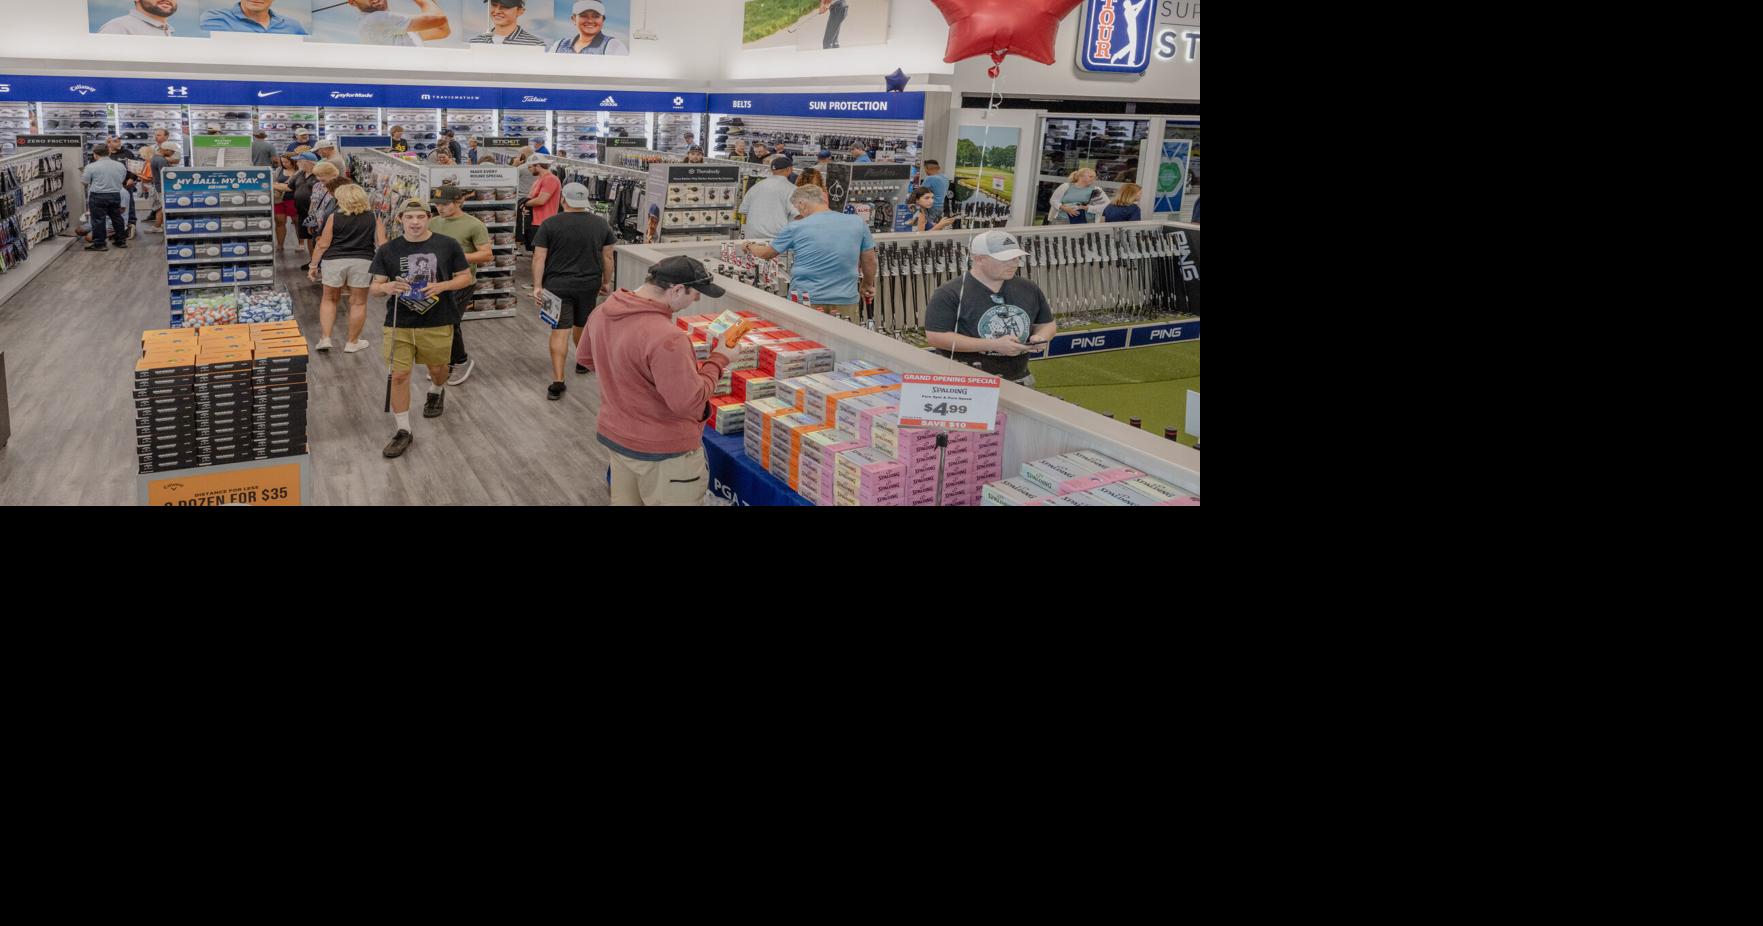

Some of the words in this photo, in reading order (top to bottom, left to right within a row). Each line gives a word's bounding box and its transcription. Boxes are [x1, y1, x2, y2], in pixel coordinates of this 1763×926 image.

[1094, 0, 1117, 58] TOUR
[733, 100, 751, 108] BELTS
[809, 101, 826, 110] SUN
[829, 101, 887, 111] PROTECTION
[1174, 230, 1199, 281] PING
[1150, 327, 1182, 340] PING
[1071, 335, 1105, 349] PING
[967, 377, 997, 385] SPECIAL
[932, 386, 967, 395] SPALDING
[924, 402, 967, 416] $4.99
[230, 491, 257, 503] FOR
[262, 486, 288, 502] $35
[714, 477, 739, 506] PGA
